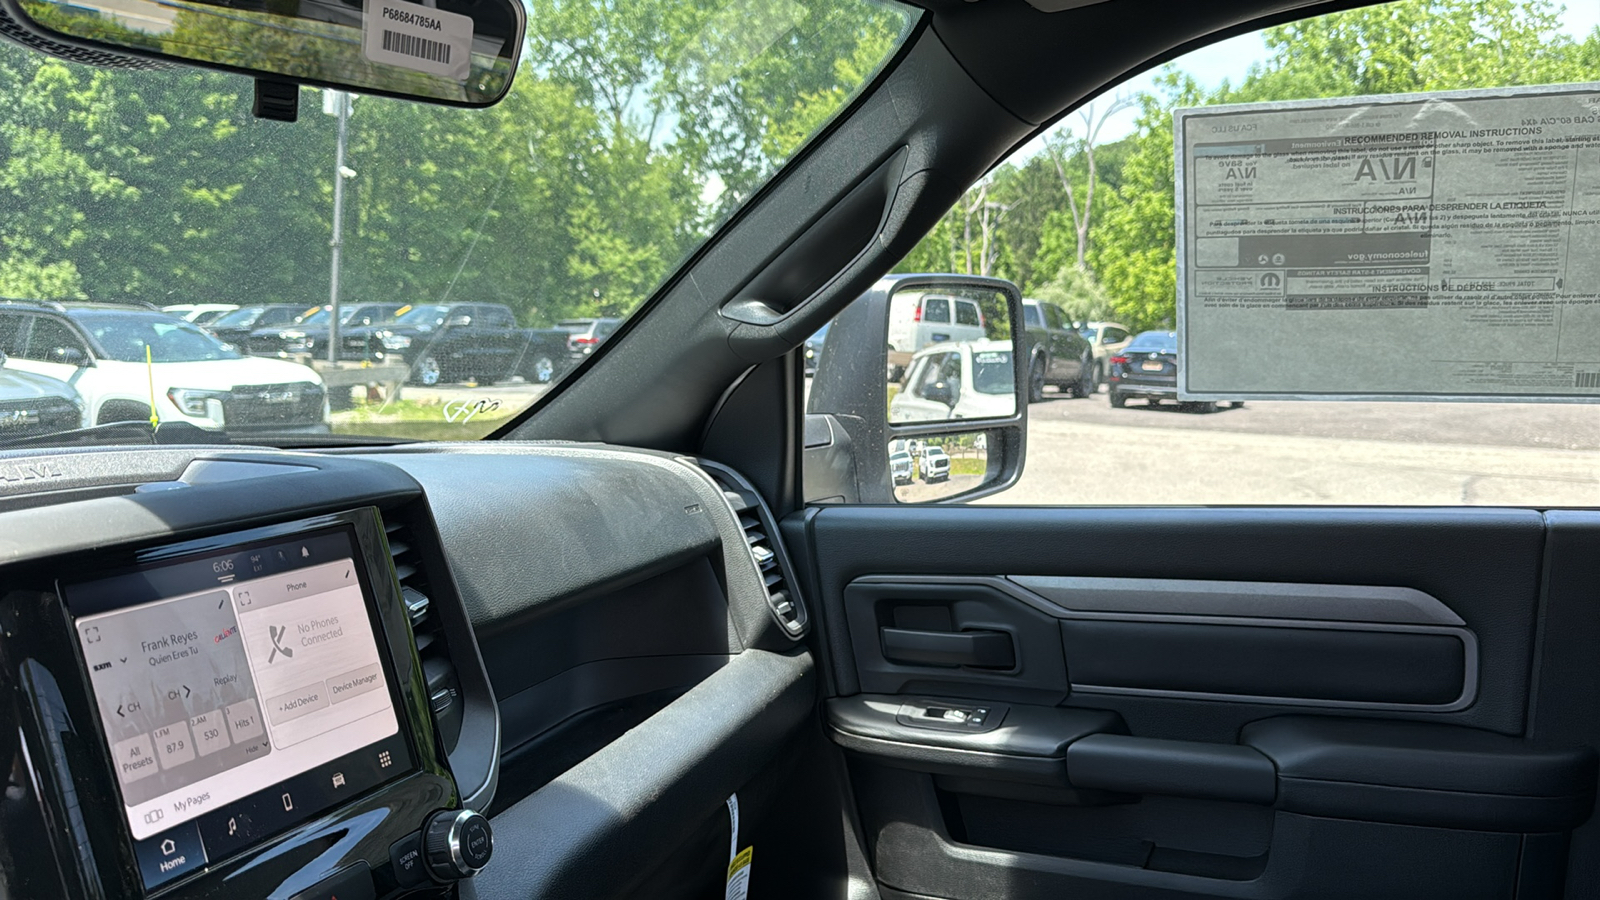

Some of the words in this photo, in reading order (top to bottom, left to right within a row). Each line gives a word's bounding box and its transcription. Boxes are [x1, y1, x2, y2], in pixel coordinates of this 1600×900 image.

[383, 7, 441, 31] P68684785AA
[1345, 133, 1419, 145] RECOMMENDED
[1421, 131, 1467, 141] REMOVAL
[1470, 127, 1542, 138] INSTRUCTIONS
[1333, 205, 1400, 215] INSTRUCCIONES
[1402, 204, 1425, 212] PARA
[1429, 203, 1488, 211] DESPRENDER
[1503, 201, 1547, 209] ETIQUETA
[1372, 284, 1439, 292] INSTRUCTIONS
[1441, 284, 1454, 292] DE
[1457, 282, 1495, 292] DÉPOSE
[213, 560, 234, 573] 6:06
[286, 581, 307, 592] Phone
[297, 623, 310, 634] No
[311, 616, 339, 631] Phones
[141, 637, 169, 653] Frank
[170, 631, 199, 646] Reyes
[301, 627, 343, 647] Connected
[148, 653, 172, 666] Quien
[172, 649, 189, 661] Eres
[189, 646, 199, 655] Tu
[93, 661, 112, 672] sxm
[214, 673, 238, 686] Replay
[332, 682, 353, 694] Device
[352, 673, 377, 687] Manager
[168, 690, 181, 701] CH
[127, 702, 141, 713] CH
[284, 700, 297, 712] Add
[297, 693, 319, 707] Device
[235, 717, 250, 729] Hits
[250, 716, 255, 724] 1
[204, 729, 219, 741] 530
[130, 746, 141, 758] All
[166, 741, 185, 754] 87.9
[245, 745, 259, 754] Hide
[122, 757, 153, 773] Presets
[173, 801, 187, 813] My
[187, 792, 211, 807] Pages
[471, 837, 484, 848] ENTER
[160, 855, 186, 873] Home
[400, 850, 418, 865] SCREEN
[405, 860, 414, 870] OFF
